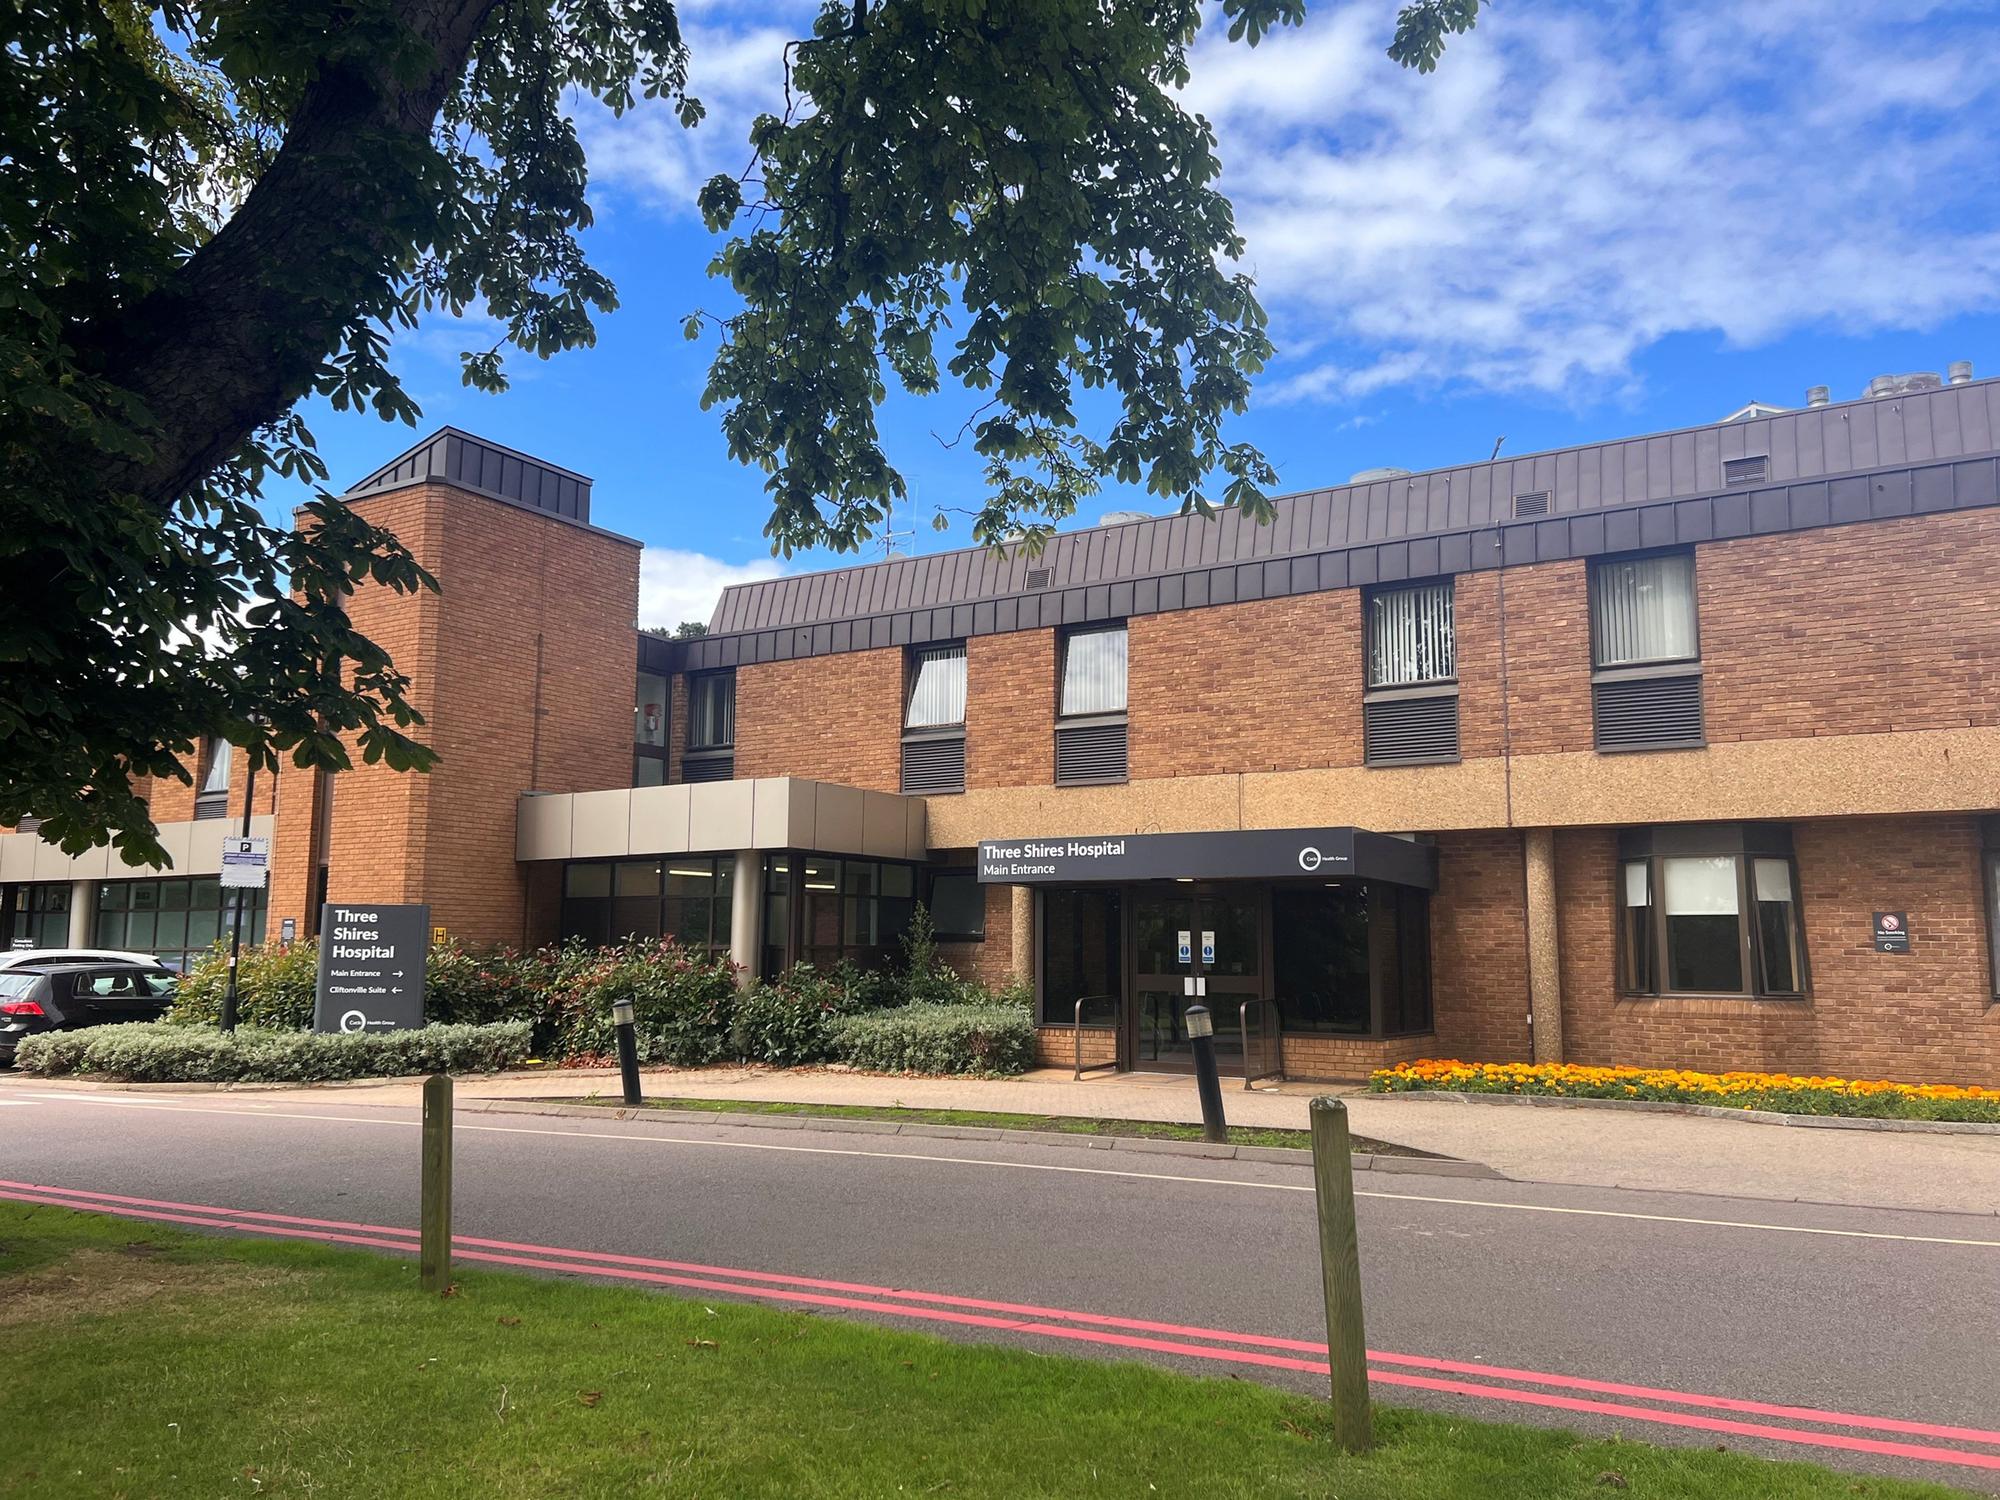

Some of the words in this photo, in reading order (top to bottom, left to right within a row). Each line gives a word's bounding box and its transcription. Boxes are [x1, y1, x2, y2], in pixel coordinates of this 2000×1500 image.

[983, 845, 1022, 860] Three
[1023, 843, 1065, 859] Shires
[1067, 840, 1125, 859] Hospital
[983, 864, 1009, 876] Main
[1011, 863, 1056, 875] Entrance
[334, 909, 379, 923] Three
[333, 927, 379, 941] Shires
[435, 929, 445, 942] H
[332, 945, 395, 961] Hospital
[330, 969, 349, 977] Main
[350, 969, 381, 977] Entrance
[329, 986, 368, 994] Cliftonville
[368, 986, 387, 994] Suite
